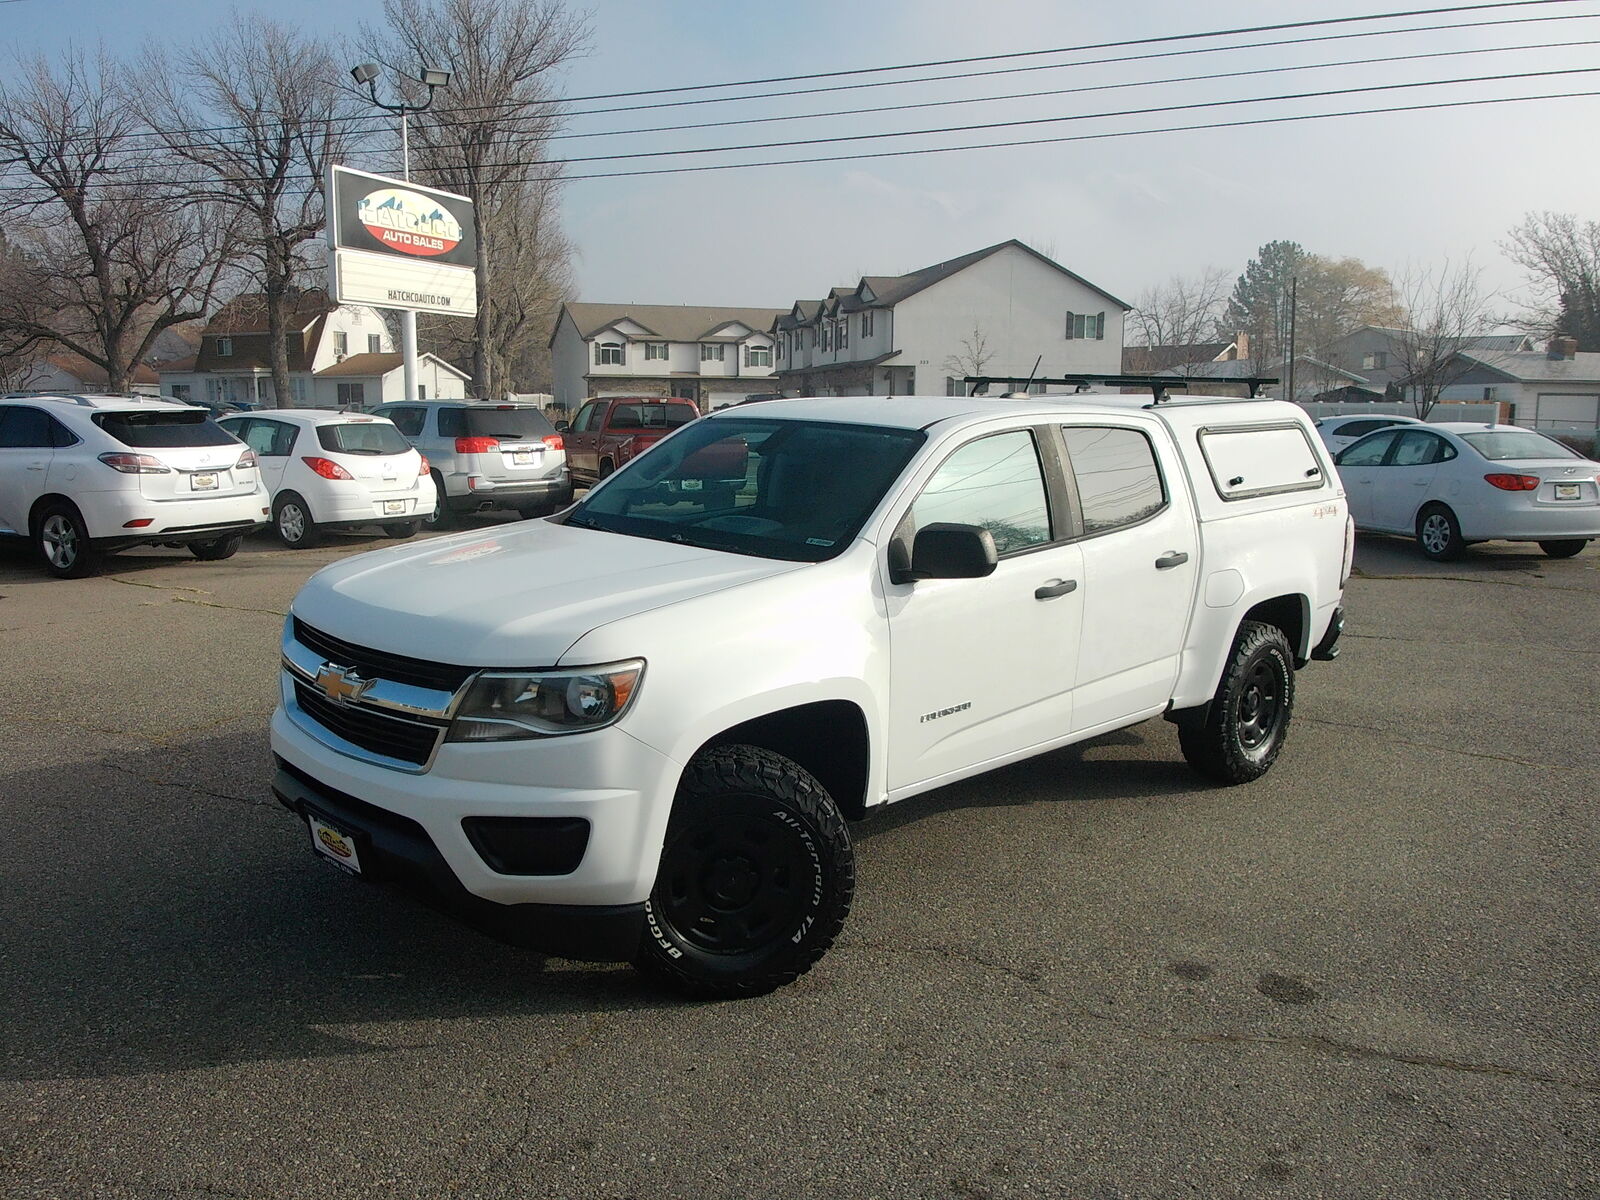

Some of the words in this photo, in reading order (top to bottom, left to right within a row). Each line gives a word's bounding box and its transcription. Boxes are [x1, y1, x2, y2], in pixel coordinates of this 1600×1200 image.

[383, 230, 412, 245] AUTO
[412, 235, 444, 250] SALES
[387, 289, 452, 307] HATCHCOAUTO.COM
[644, 900, 683, 959] BFGoo
[791, 915, 815, 944] T/A
